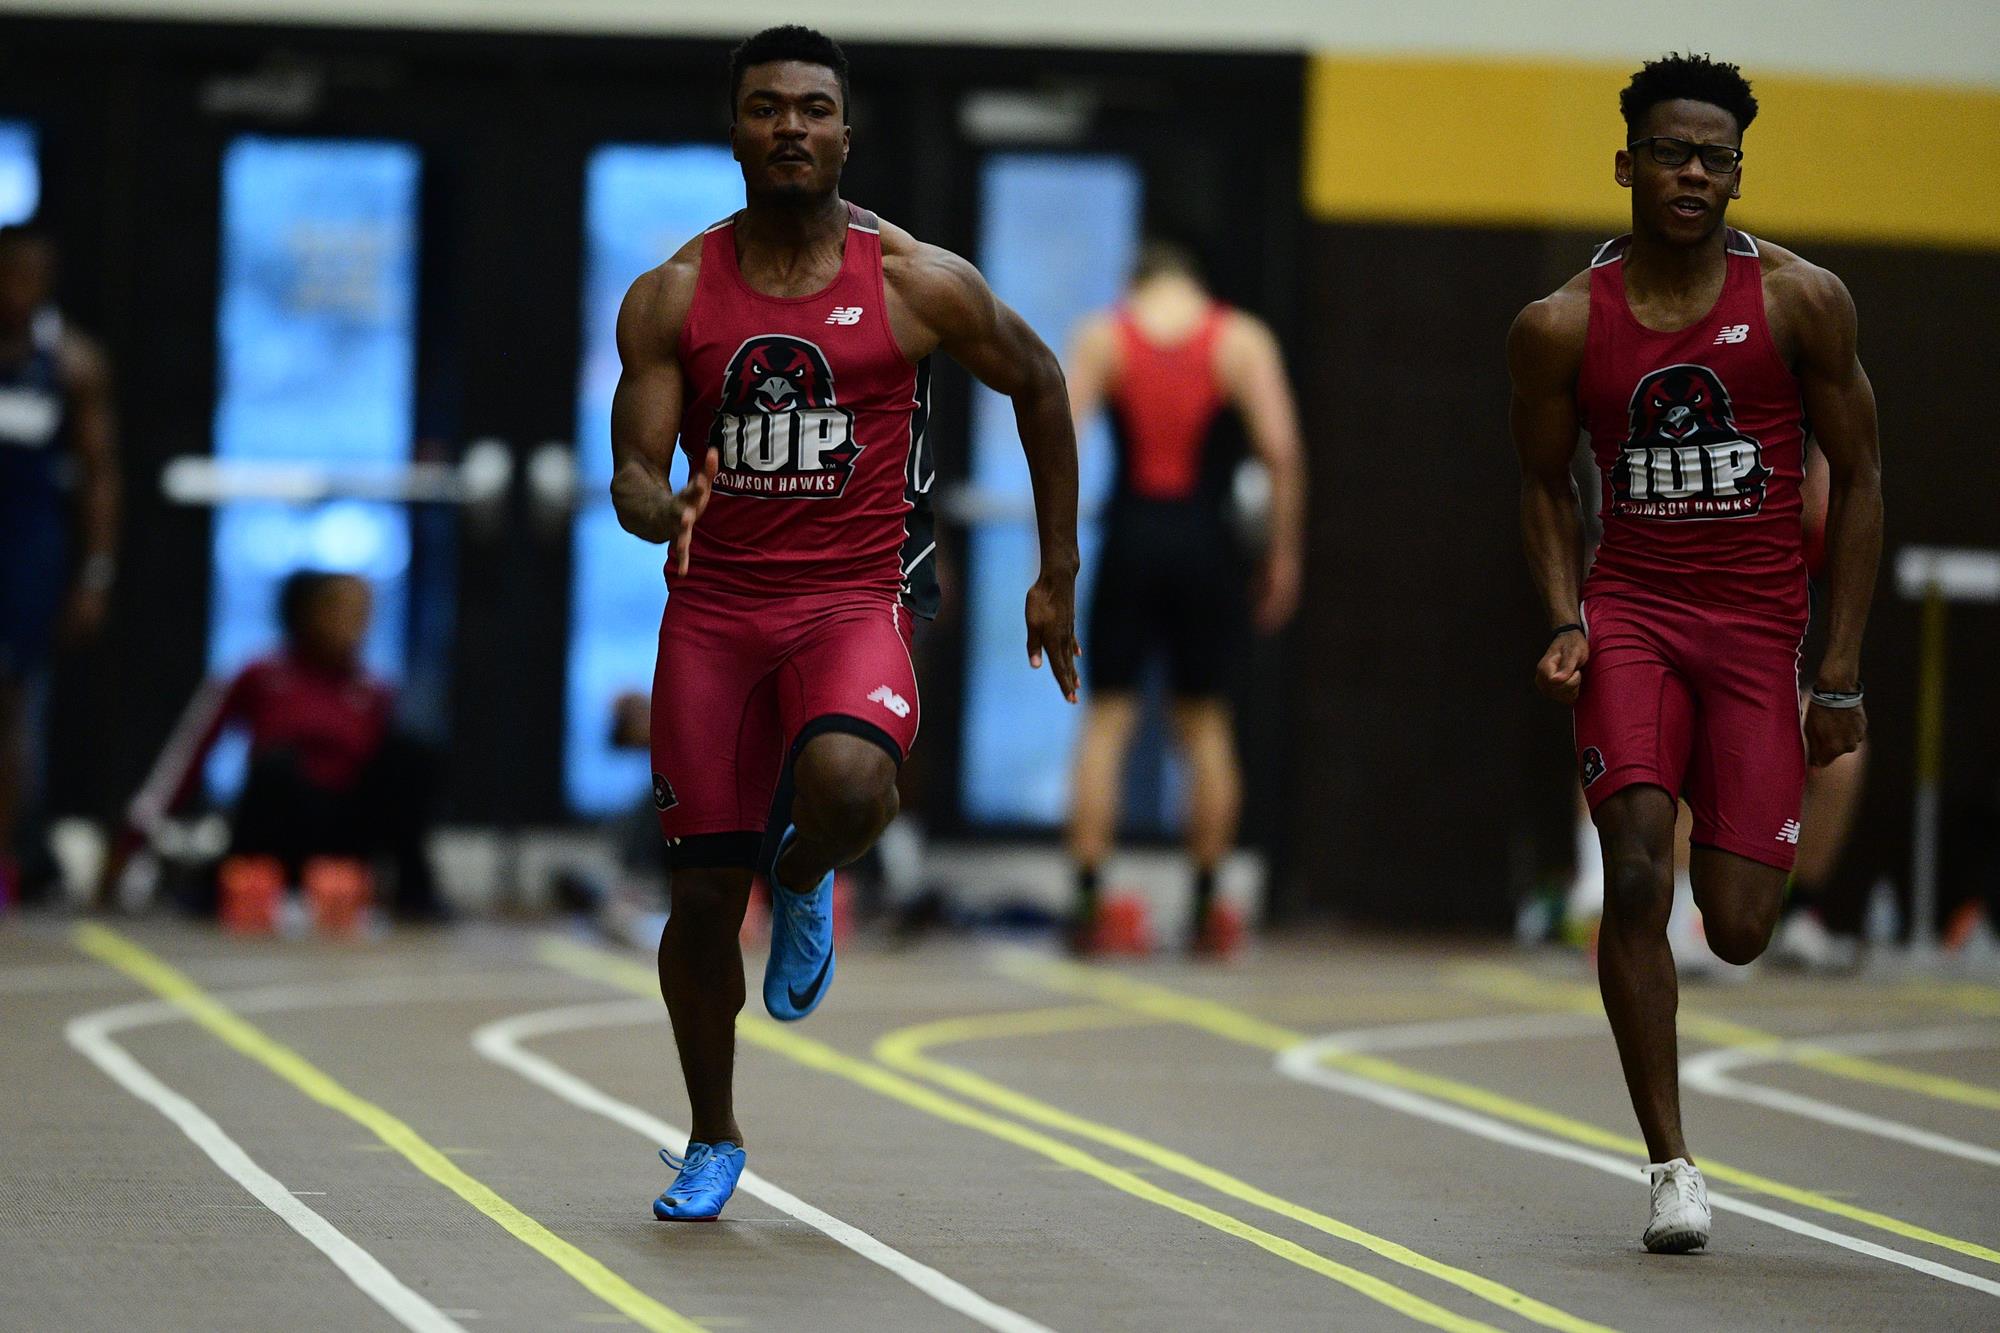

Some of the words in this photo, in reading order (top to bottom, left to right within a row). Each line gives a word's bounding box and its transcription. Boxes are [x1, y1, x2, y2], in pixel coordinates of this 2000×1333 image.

[824, 306, 863, 325] NB
[1712, 324, 1750, 345] NB
[721, 407, 849, 472] IUP
[1624, 440, 1757, 500] IUP
[713, 472, 773, 491] CRIMSON
[778, 475, 836, 491] HAWKS
[1695, 498, 1752, 512] HAWKS
